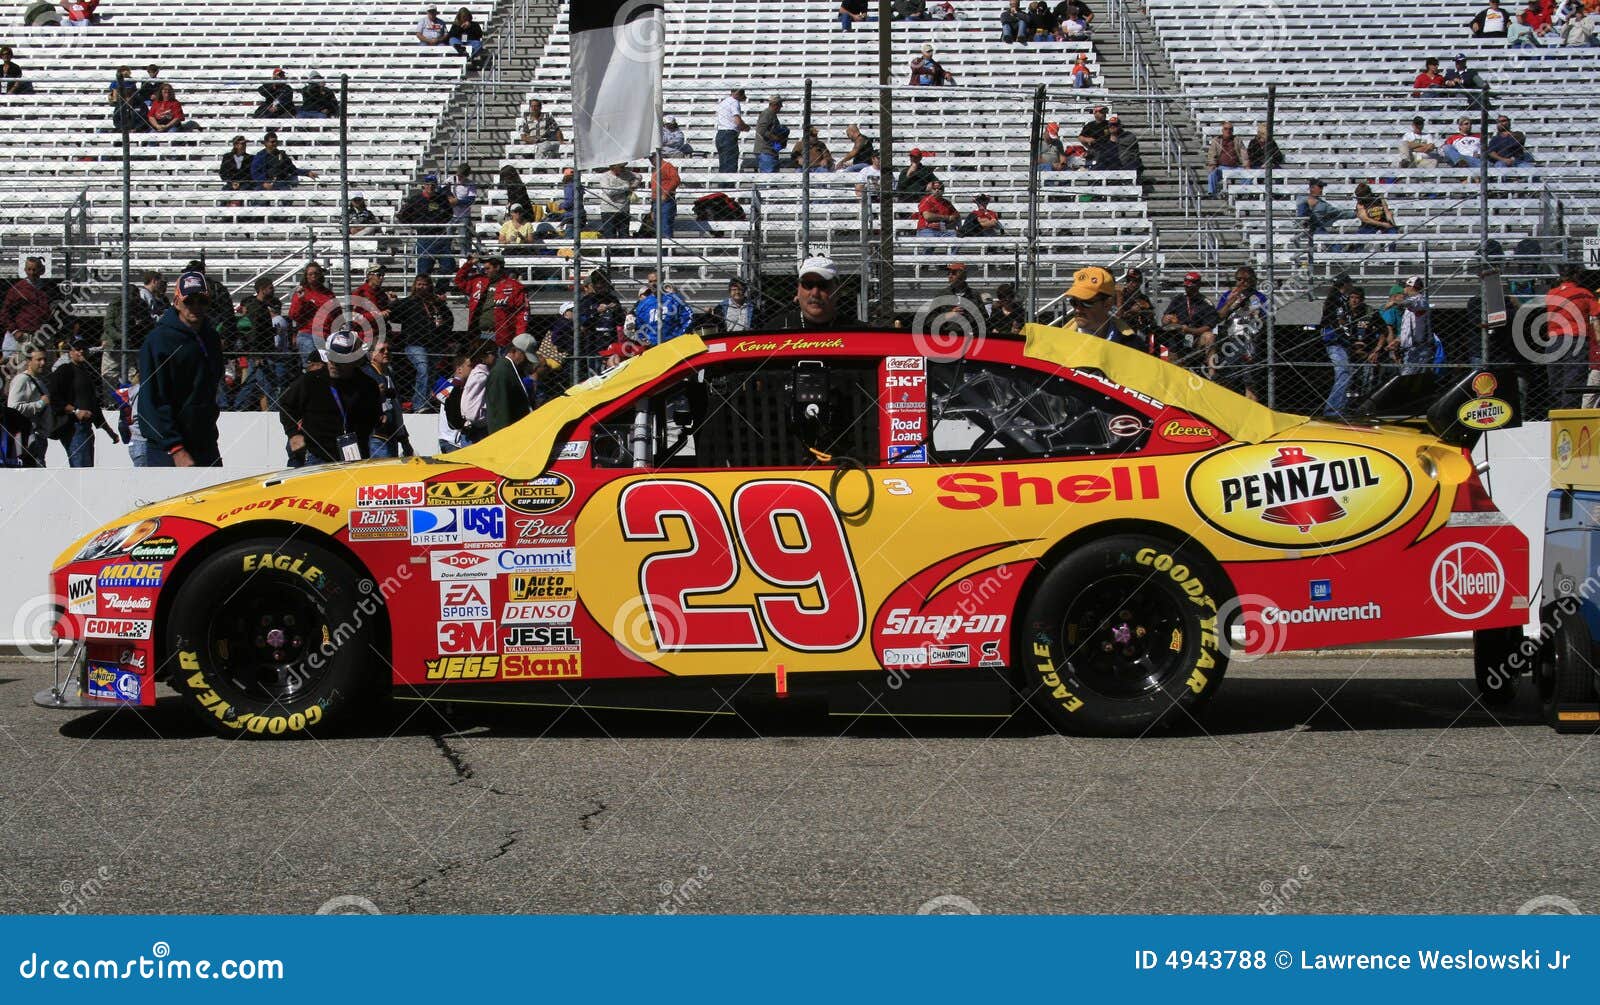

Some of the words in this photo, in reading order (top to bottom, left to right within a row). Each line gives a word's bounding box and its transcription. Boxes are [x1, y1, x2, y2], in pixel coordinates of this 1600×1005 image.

[732, 340, 777, 352] Kevin
[886, 376, 925, 387] SKF
[1466, 405, 1505, 420] PENNZOIL
[891, 416, 922, 430] Road
[891, 430, 923, 441] Loans
[358, 484, 423, 504] Holley
[514, 487, 558, 496] NEXTEL
[882, 478, 913, 495] 3
[937, 465, 1159, 510] Shell
[1221, 456, 1379, 513] PENNZOIL
[216, 496, 341, 521] GOODYEAR
[426, 497, 470, 506] MECHANIX
[471, 496, 496, 504] WEAR
[463, 507, 504, 539] USG
[514, 518, 572, 537] Bud
[413, 534, 459, 544] DIRECTV
[463, 541, 504, 549] SHEETROCK
[243, 553, 324, 583] EAGLE
[498, 549, 572, 570] Commit
[617, 478, 867, 654] 29
[99, 563, 163, 579] MOOG
[1442, 548, 1498, 604] Rheem
[69, 577, 94, 600] WIX
[527, 575, 564, 587] Auto
[1314, 585, 1327, 596] GM
[444, 584, 487, 606] EA
[526, 586, 573, 597] Meter
[443, 606, 489, 618] SPORTS
[505, 604, 571, 620] DENSO
[1135, 547, 1219, 694] GOODYEAR
[1261, 601, 1381, 625] Goodwrench
[87, 620, 134, 634] COMP
[881, 608, 1007, 640] Snap-on
[439, 621, 495, 653] 3M
[504, 627, 580, 646] JESEL
[932, 650, 967, 660] CHAMPION
[426, 656, 500, 679] JEGS
[503, 655, 579, 677] Stant
[1033, 641, 1085, 713] EAGLE
